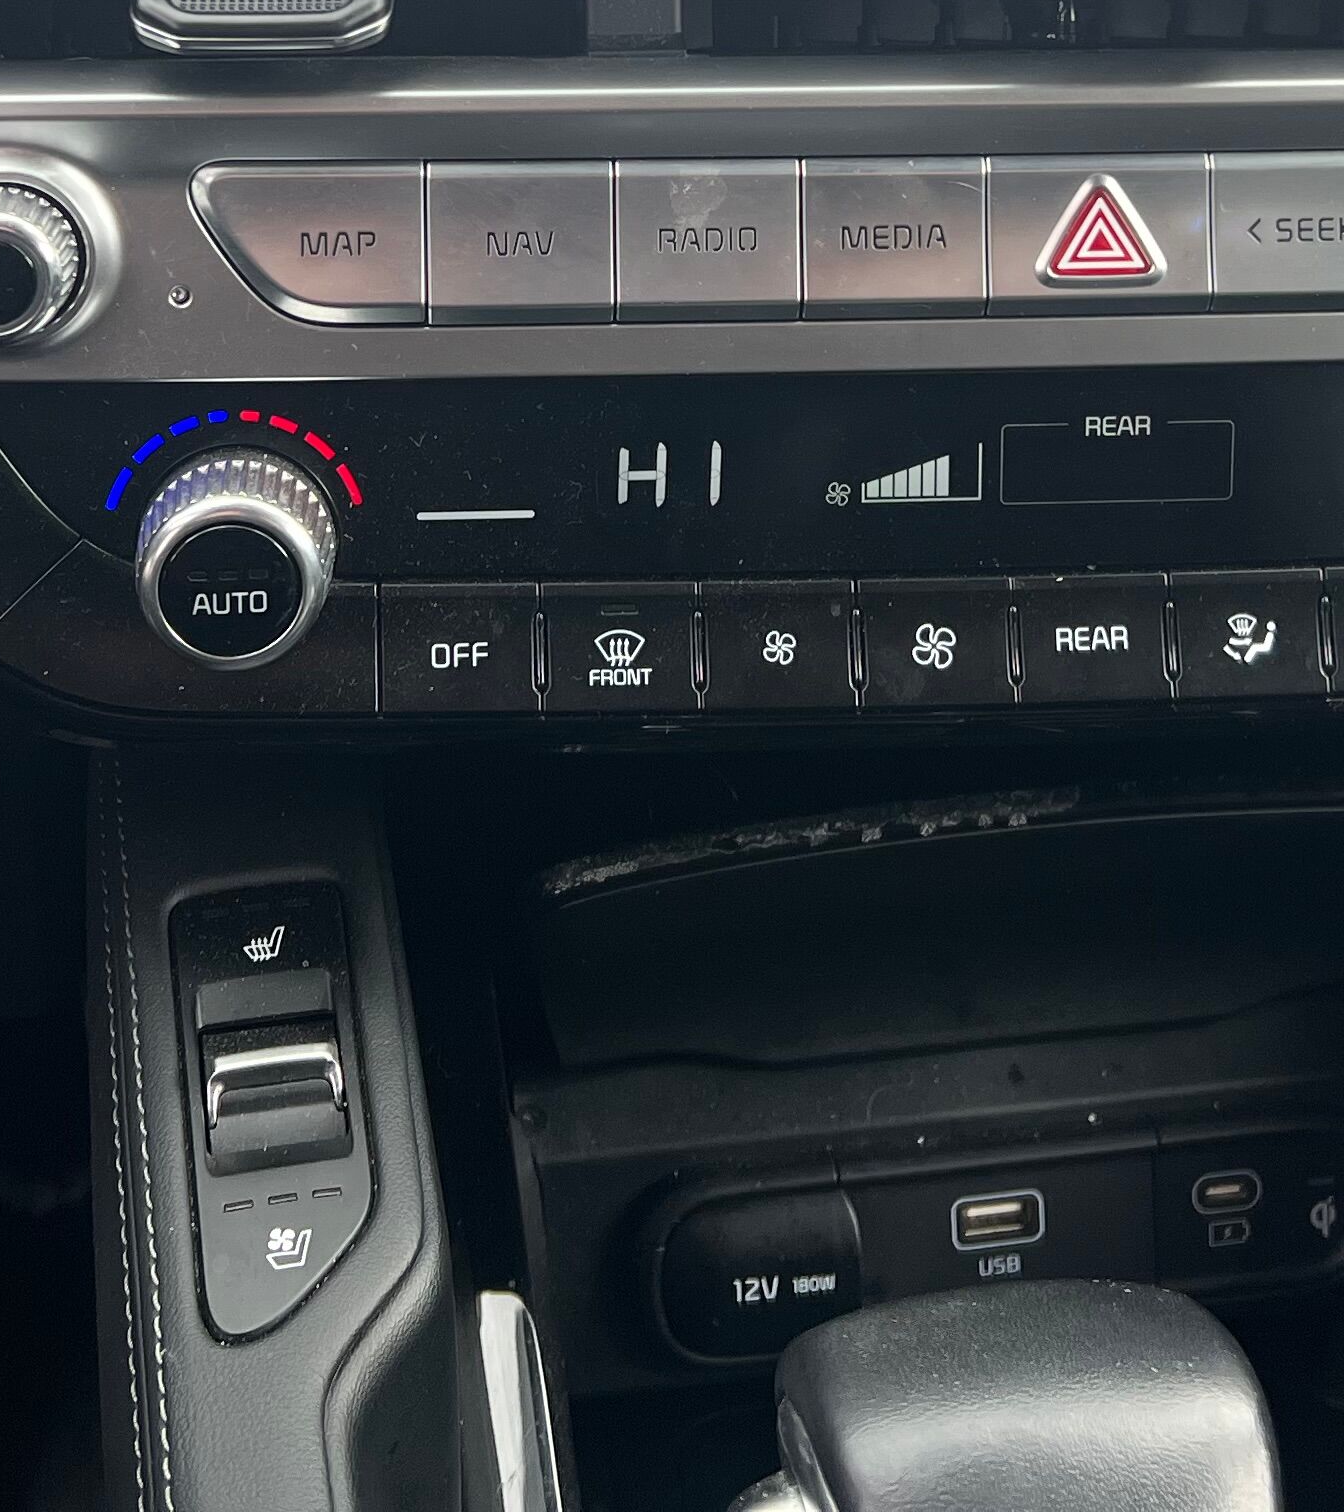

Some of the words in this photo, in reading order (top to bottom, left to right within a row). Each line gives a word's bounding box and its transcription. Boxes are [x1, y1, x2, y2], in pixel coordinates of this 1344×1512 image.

[299, 230, 377, 258] MAP
[485, 229, 555, 257] NAV
[656, 227, 759, 254] RADIO
[840, 223, 948, 251] MEDIA
[1083, 414, 1153, 437] REAR
[192, 591, 269, 617] AUTO
[1056, 625, 1129, 652] REAR
[430, 642, 489, 669] OFF
[588, 669, 653, 688] FRONT
[979, 1255, 1022, 1277] USB
[733, 1275, 780, 1303] 12V
